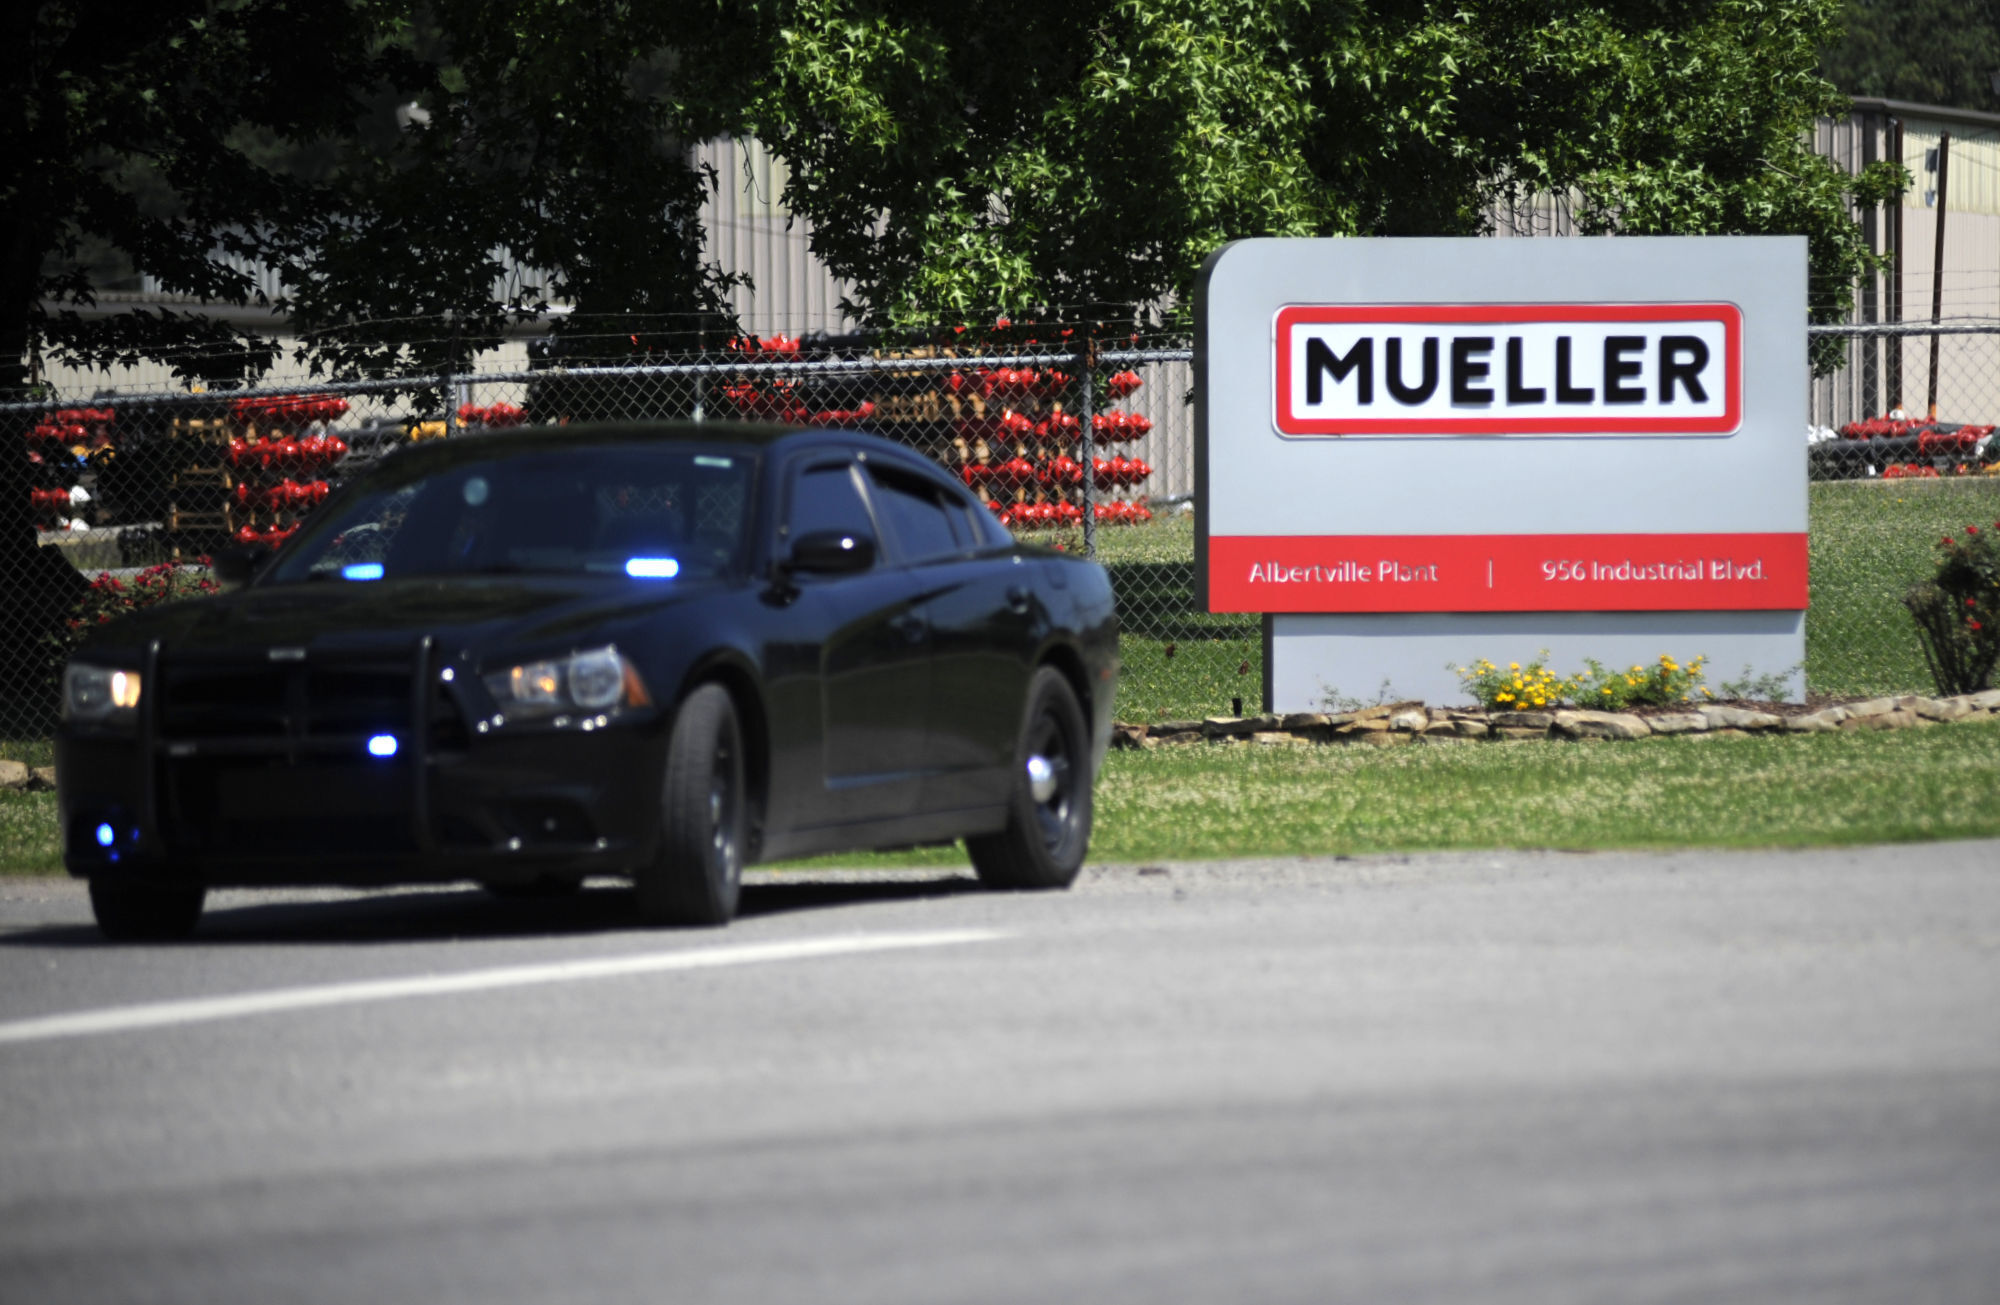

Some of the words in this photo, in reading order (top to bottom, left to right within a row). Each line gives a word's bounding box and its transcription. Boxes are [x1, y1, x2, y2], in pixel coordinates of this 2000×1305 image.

[1306, 336, 1711, 406] MUELLER
[1249, 561, 1372, 583] Albertville
[1378, 561, 1439, 583] Plant
[1541, 559, 1586, 581] 956
[1591, 559, 1704, 581] Industrial
[1709, 559, 1769, 581] Blvd.
